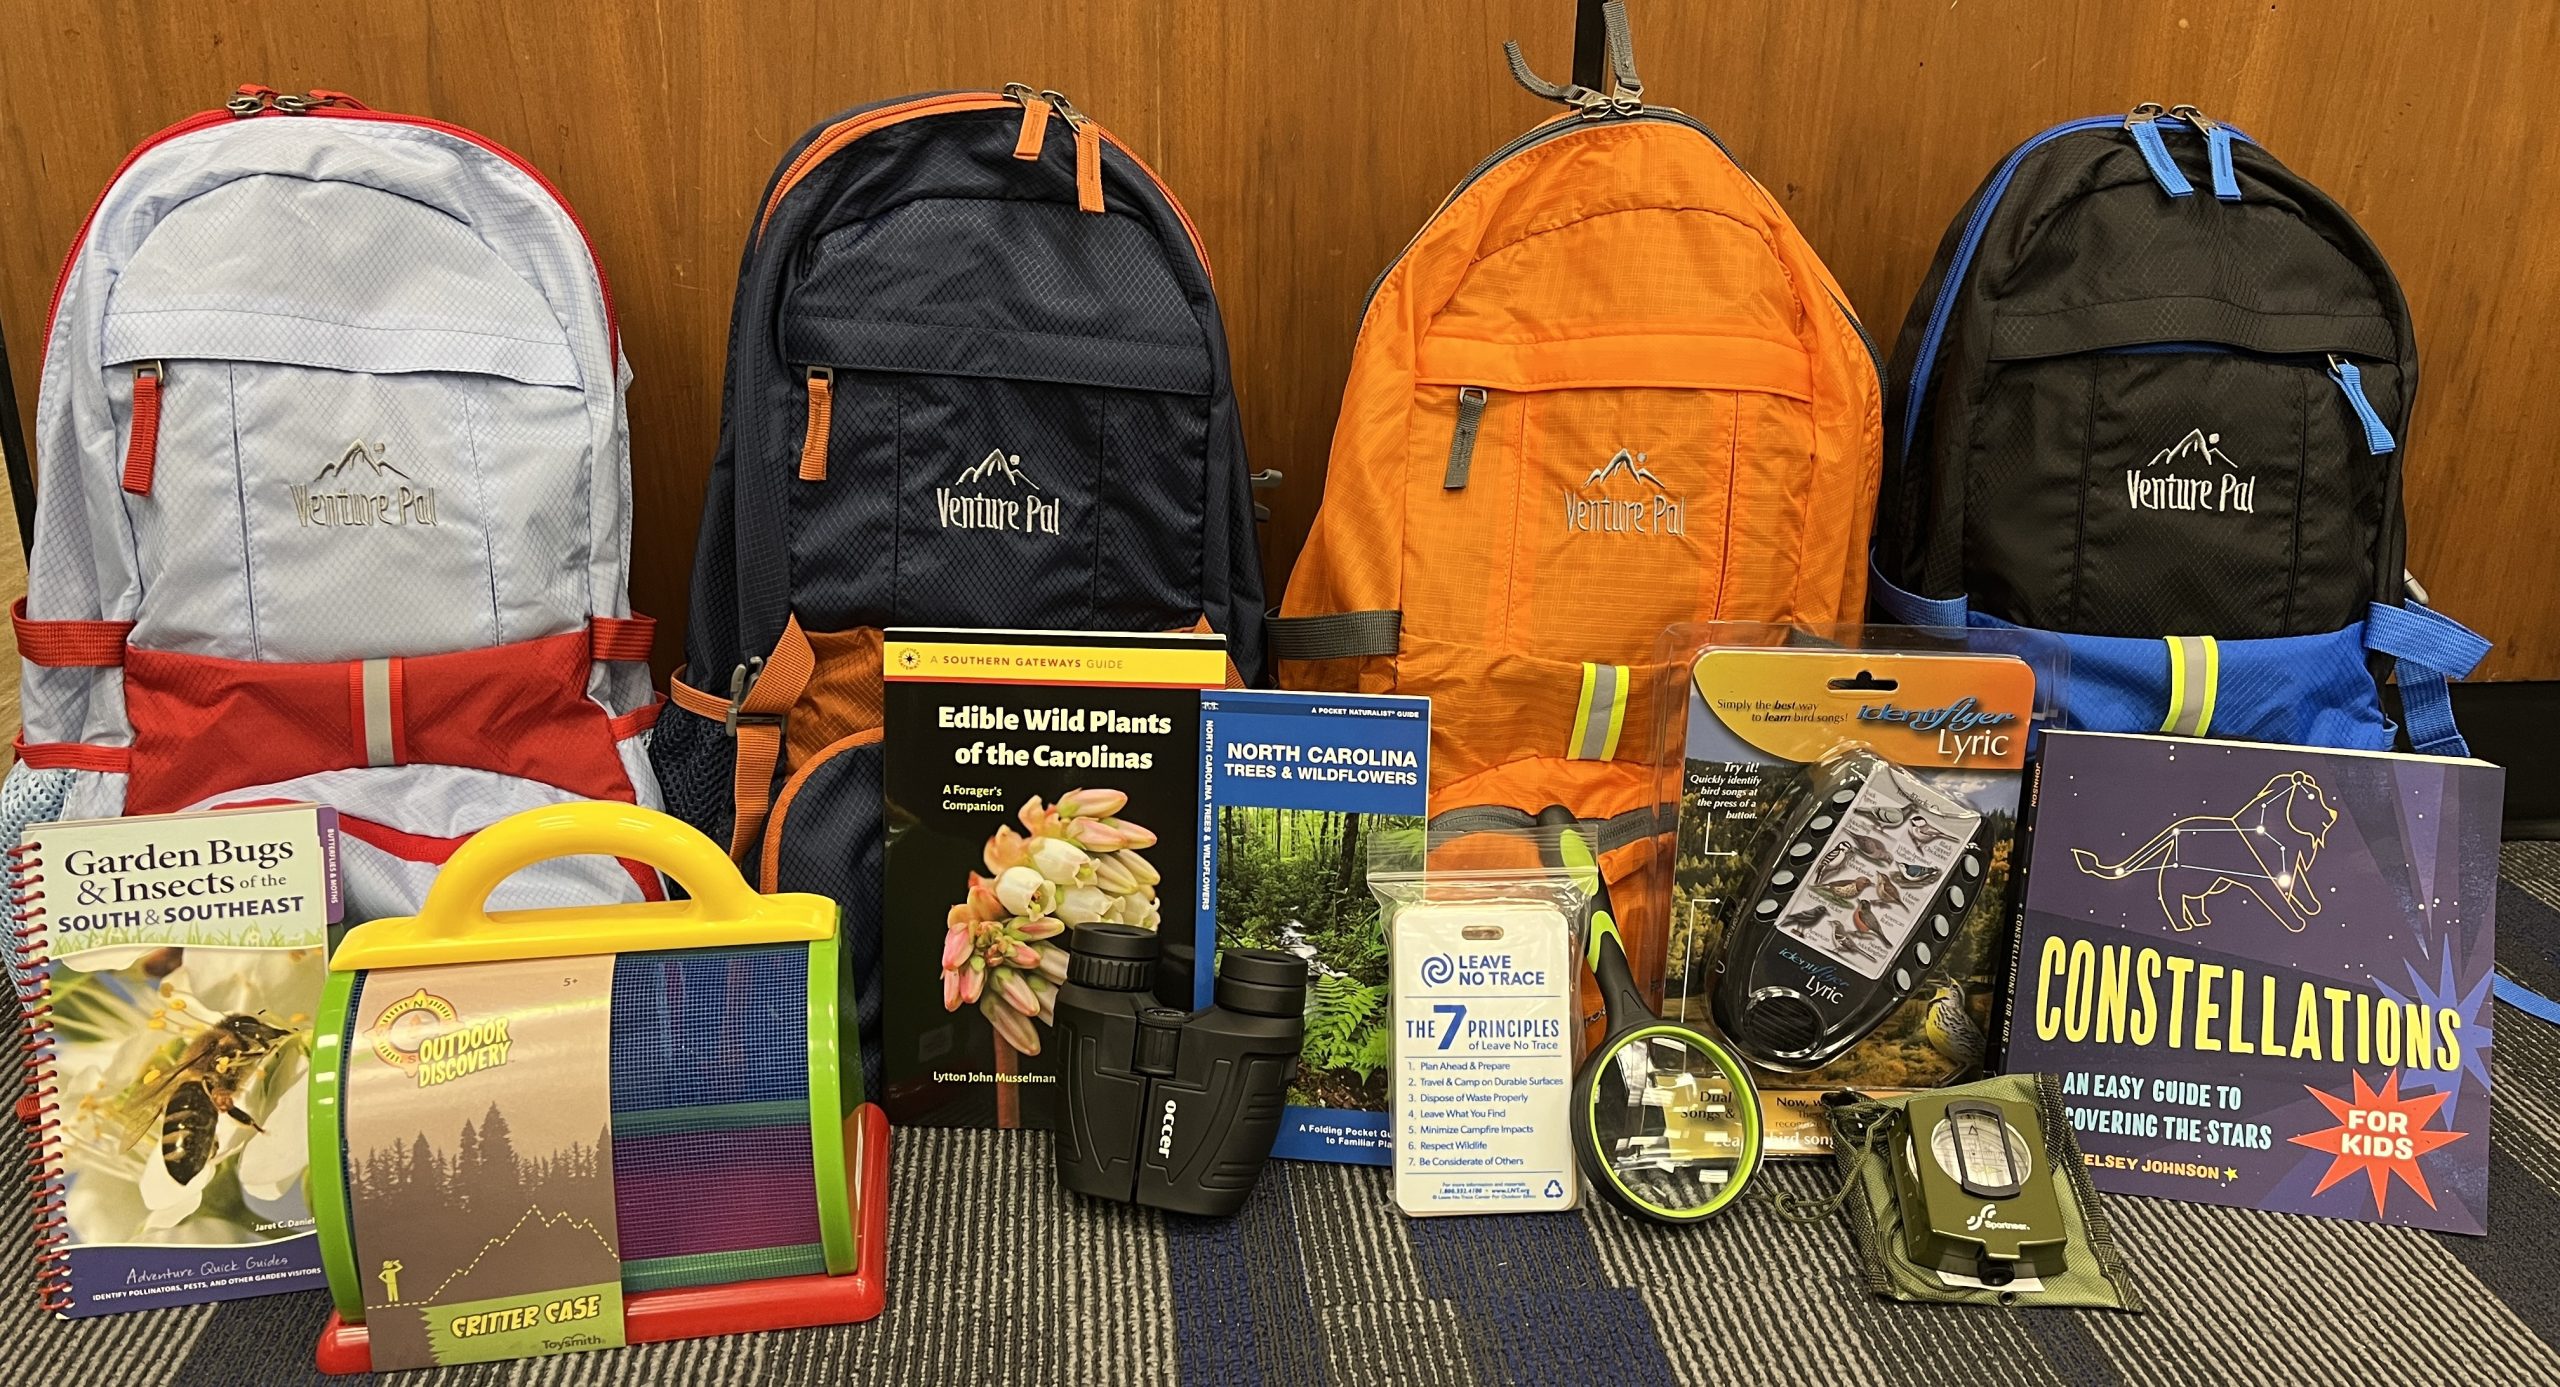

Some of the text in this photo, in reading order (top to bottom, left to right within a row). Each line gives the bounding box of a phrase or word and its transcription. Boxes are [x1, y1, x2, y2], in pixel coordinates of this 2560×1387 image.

[2127, 470, 2255, 513] Venture Pal
[290, 483, 437, 528] Venture Pal
[936, 487, 1060, 535] Venture Pal
[1564, 490, 1686, 536] Venture Pal
[930, 656, 938, 664] A
[943, 656, 1010, 666] SOUTHERN
[1015, 657, 1081, 668] GATEWAYS
[1086, 659, 1123, 669] GUIDE
[1717, 699, 1818, 713] Simply the best way
[1752, 712, 1848, 724] to learn bird songs!
[938, 705, 1172, 734] Edible Wild Plants
[1205, 720, 1213, 752] NORTH
[1937, 729, 2009, 764] Lyric
[955, 741, 1153, 769] of the Carolinas
[1227, 742, 1418, 768] NORTH CAROLINA
[1725, 761, 1760, 775] Try it!
[1204, 754, 1213, 801] CAROLINA
[1224, 763, 1417, 786] TREES & WILDFLOWERS
[1690, 774, 1762, 787] Quickly identify
[2031, 762, 2041, 808] JOHNSON
[943, 785, 1002, 798] A Forager's
[1697, 798, 1750, 809] the press of
[1701, 786, 1758, 798] bird songs at
[942, 800, 1004, 813] Companion
[1203, 803, 1212, 833] TREES
[1726, 810, 1758, 819] button.
[64, 839, 294, 877] Garden Bugs
[76, 872, 286, 906] & Insects of the
[1202, 844, 1211, 911] WILDFLOWERS
[58, 896, 304, 933] SOUTH & SOUTHEAST
[1458, 955, 1511, 969] LEAVE
[563, 977, 578, 987] 5+
[1458, 971, 1545, 986] NO TRACE
[1805, 975, 1844, 1005] Lyric
[2002, 914, 2023, 1043] CONSTELLATIONS FOR KIDS
[2035, 934, 2462, 1072] CONSTELLATIONS
[1406, 1004, 1560, 1050] THE 7 PRINCIPLES
[419, 1017, 512, 1064] OUTDOOR
[1468, 1040, 1558, 1050] of Leave No Trace
[418, 1040, 513, 1088] DISCOVERY
[933, 1071, 1056, 1083] Lytton John Musselman
[1420, 1062, 1510, 1072] Plan Ahead & Prepare
[1420, 1077, 1444, 1086] Travel
[1446, 1078, 1453, 1086] &
[1455, 1078, 1480, 1088] Camp
[1495, 1077, 1527, 1086] Durable
[1529, 1077, 1563, 1085] Surfaces
[2063, 1071, 2242, 1111] AN EASY GUIDE TO
[1420, 1093, 1528, 1103] Dispose of Waste Properly
[1700, 1091, 1732, 1103] Dual
[1776, 1096, 1809, 1108] Now,
[1420, 1109, 1506, 1118] Leave What You Find
[1725, 1110, 1736, 1119] &
[2347, 1108, 2408, 1135] FOR
[1159, 1100, 1176, 1159] occer
[1299, 1124, 1377, 1137] A Folding Pocket
[1338, 1137, 1375, 1147] Familiar
[1420, 1125, 1534, 1135] Minimize Campfire Impacts
[2163, 1116, 2201, 1143] THE
[2207, 1120, 2272, 1150] STARS
[1420, 1141, 1487, 1152] Respect Wildlife
[2341, 1133, 2414, 1161] KIDS
[1420, 1157, 1524, 1166] Be Considerate of Others
[2082, 1153, 2220, 1180] ELSEY JOHNSON
[254, 1221, 277, 1232] Jaret
[126, 1253, 288, 1285] Adventure Quick Guides
[92, 1267, 322, 1301] IDENTIFY POLLINATORS, PESTS, AND OTHER GARDEN VISITORS
[450, 1294, 601, 1339] CRITTER CASE
[542, 1334, 601, 1350] Toysmith
